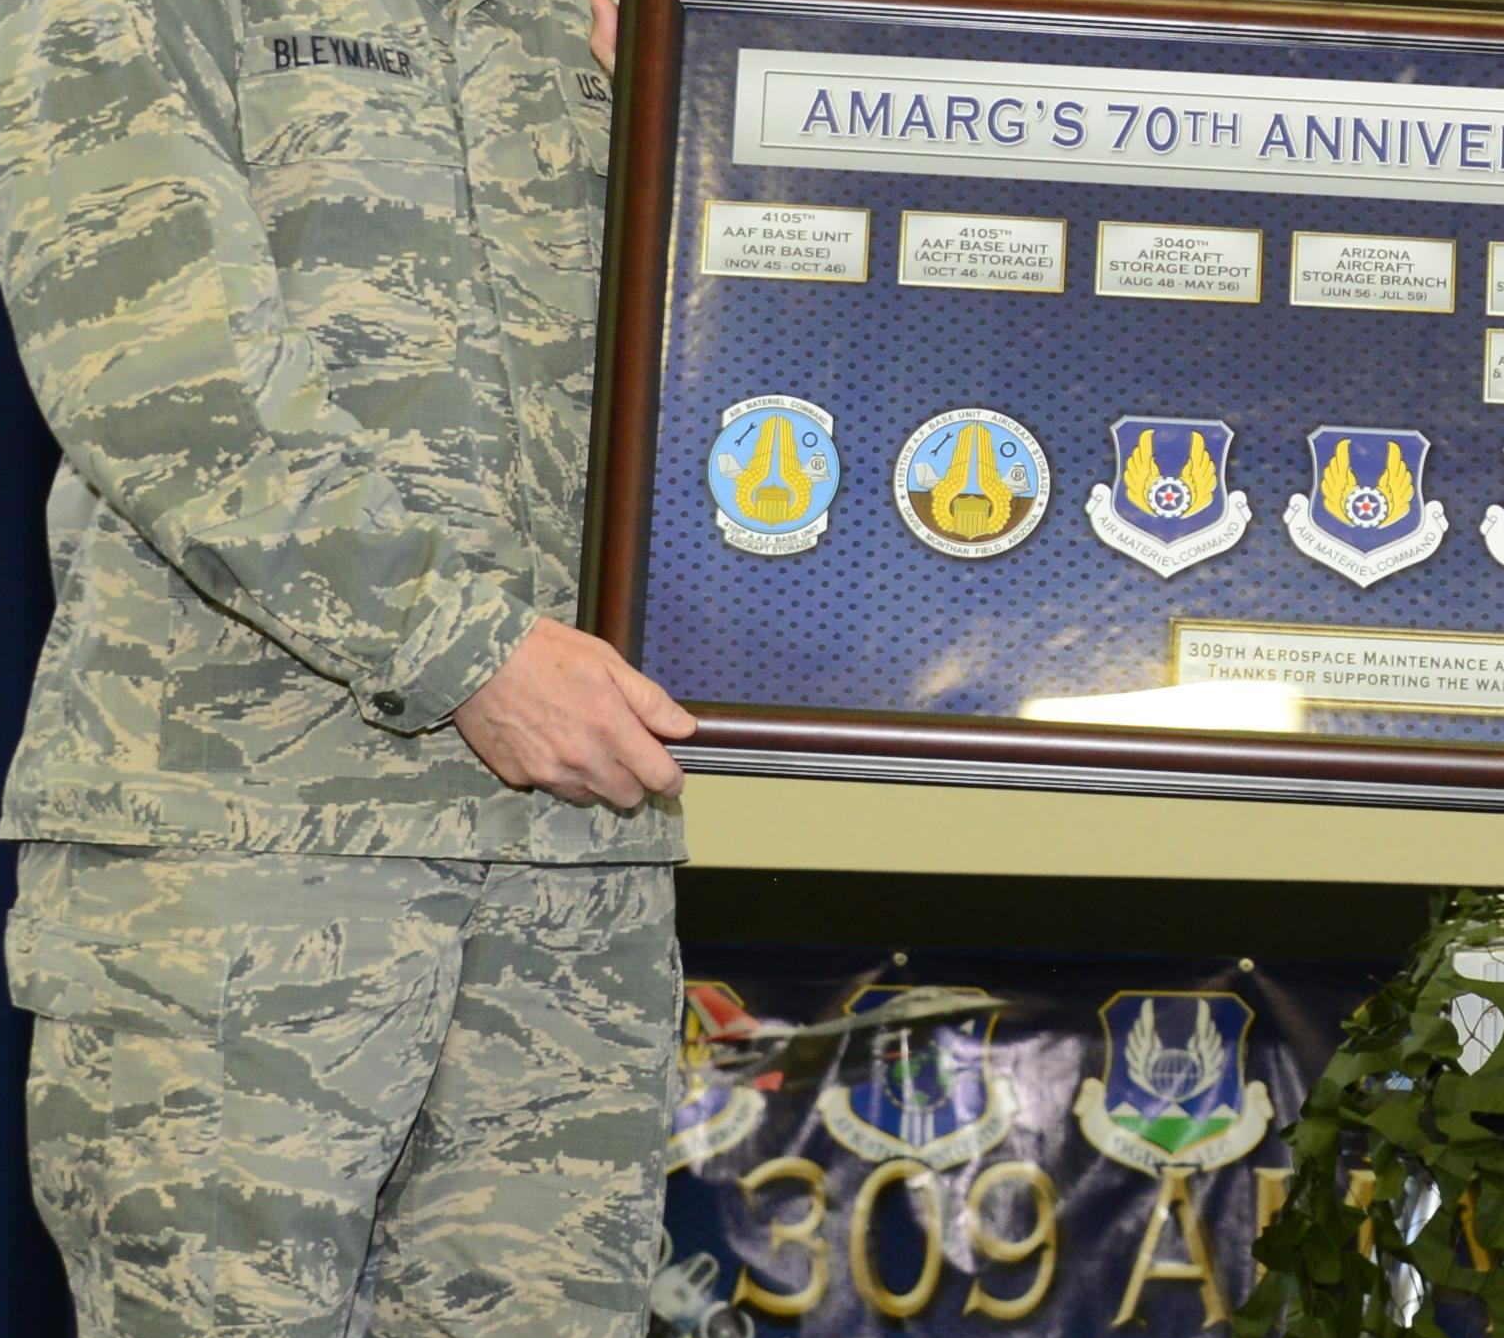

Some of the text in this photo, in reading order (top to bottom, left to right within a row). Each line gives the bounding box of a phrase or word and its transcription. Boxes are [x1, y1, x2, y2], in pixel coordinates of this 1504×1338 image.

[274, 35, 413, 78] BLEYMAIER
[801, 88, 1085, 148] AMARG'S
[1106, 103, 1239, 152] 70TH
[721, 225, 853, 244] AAF BASE UNIT
[741, 243, 831, 260] (AIR BASE)
[919, 236, 1049, 256] AAF BASE UNIT
[1339, 246, 1411, 262] ARIZONA
[913, 248, 1054, 269] (ACFT STORAGE)
[1136, 248, 1225, 264] AIRCRAFT
[723, 257, 847, 275] (NOV 45 OCT 46)
[921, 264, 1044, 283] (OCT 46 AUG 48)
[1108, 259, 1252, 278] STORAGE DEPOT
[1335, 258, 1416, 275] AIRCRAFT
[1118, 275, 1240, 292] (AUG 48 MAY 56)
[1301, 269, 1448, 289] STORAGE BRANCH
[1320, 286, 1428, 302] (JUN 56 JUL 59)
[1491, 366, 1503, 380] &
[929, 414, 954, 430] BASE
[958, 411, 982, 420] UNIT
[991, 414, 1035, 447] AIRCRAFT
[1098, 514, 1241, 568] AIR MATERIEL COMMAND
[1295, 525, 1438, 577] AIR MATERIEL COMMAND
[1187, 641, 1246, 660] 309TH
[1251, 645, 1357, 666] AEROSPACE
[1362, 650, 1489, 672] MAINTENANCE
[1282, 668, 1317, 683] FOR
[1321, 670, 1431, 689] SUPPORTING
[1435, 675, 1470, 691] THE
[732, 1157, 1058, 1319] 309
